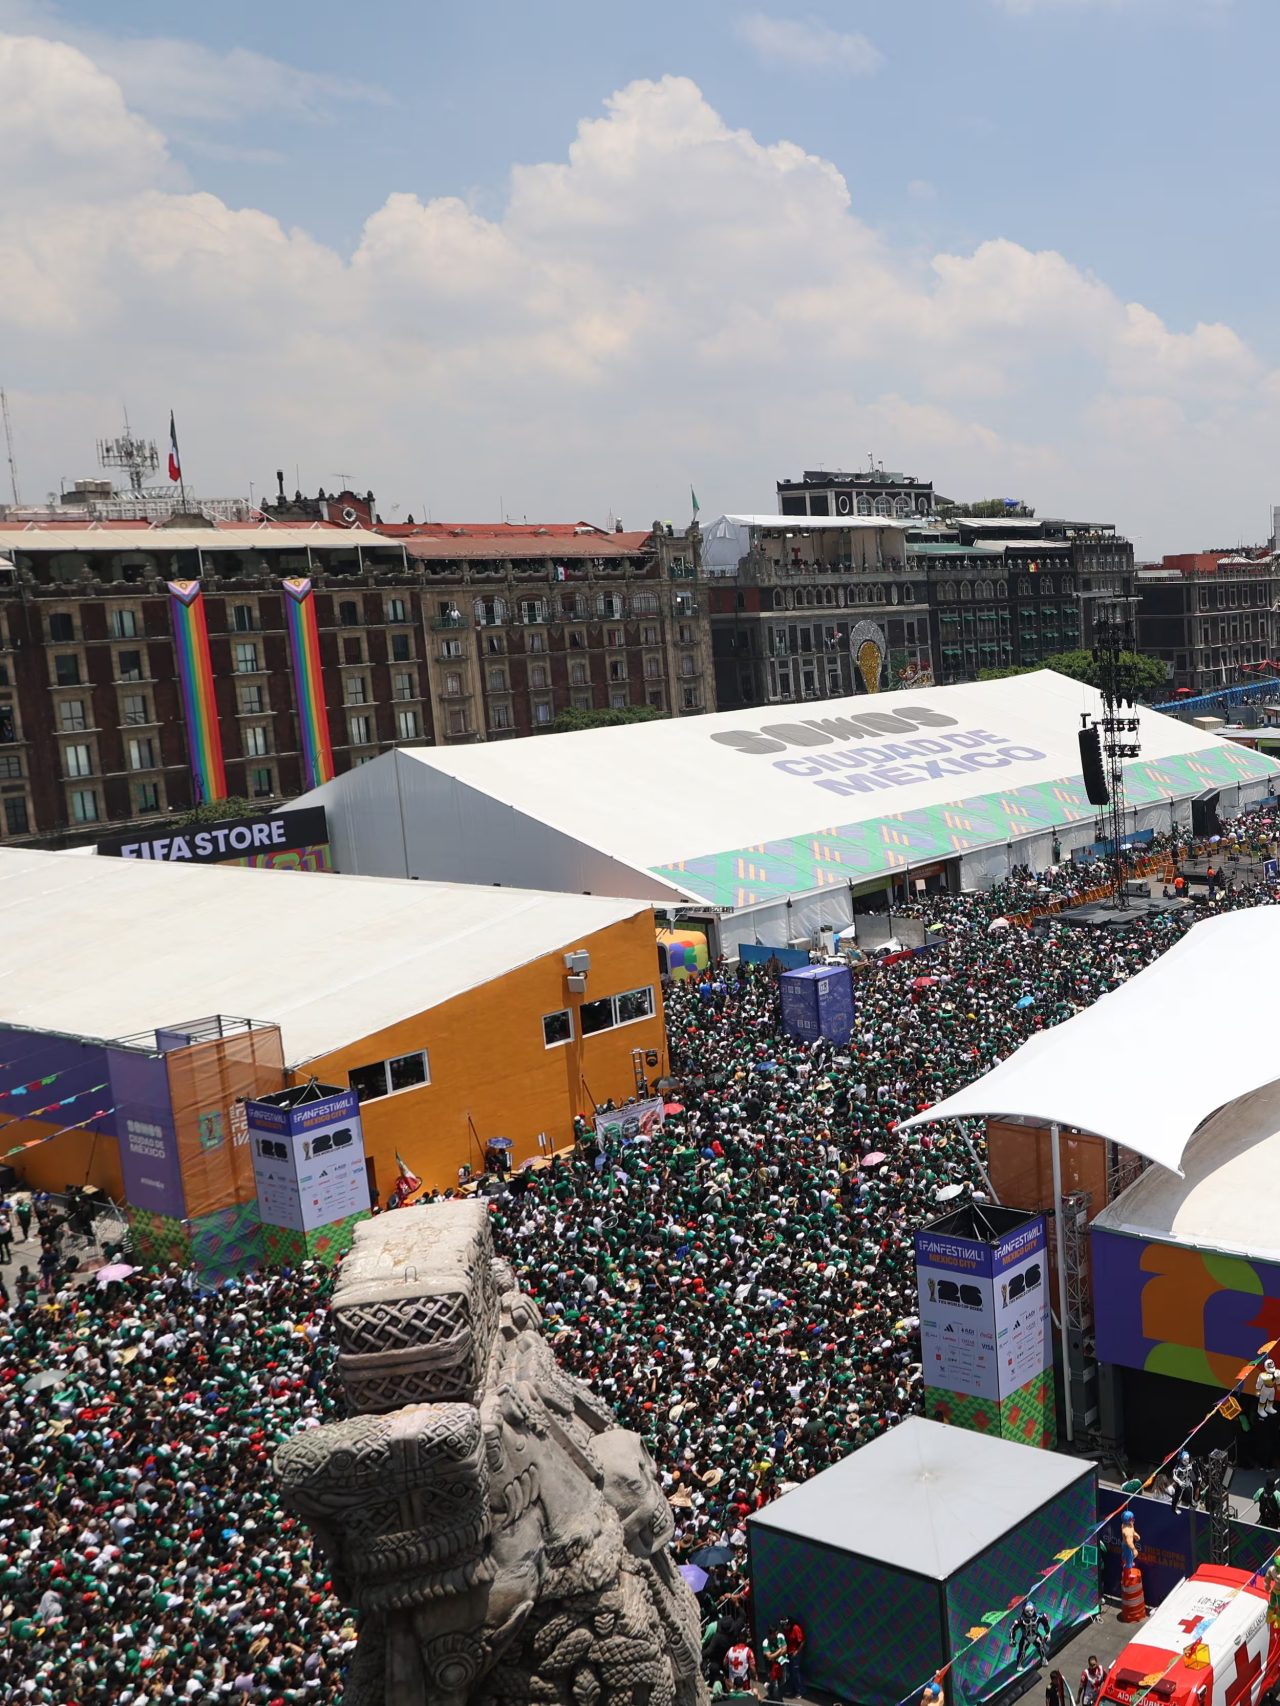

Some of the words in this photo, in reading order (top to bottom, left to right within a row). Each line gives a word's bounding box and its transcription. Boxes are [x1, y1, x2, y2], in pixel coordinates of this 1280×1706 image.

[710, 706, 959, 755] SOMOS
[772, 734, 953, 777] CIUDAD
[940, 729, 1012, 749] DE
[812, 746, 1047, 797] MÉXICO
[194, 820, 287, 856] STORE
[928, 1253, 960, 1266] MEXICO
[959, 1260, 977, 1269] CITY
[1002, 1247, 1025, 1265] MEXICO
[1024, 1238, 1038, 1252] CITY
[981, 1343, 995, 1352] VISA
